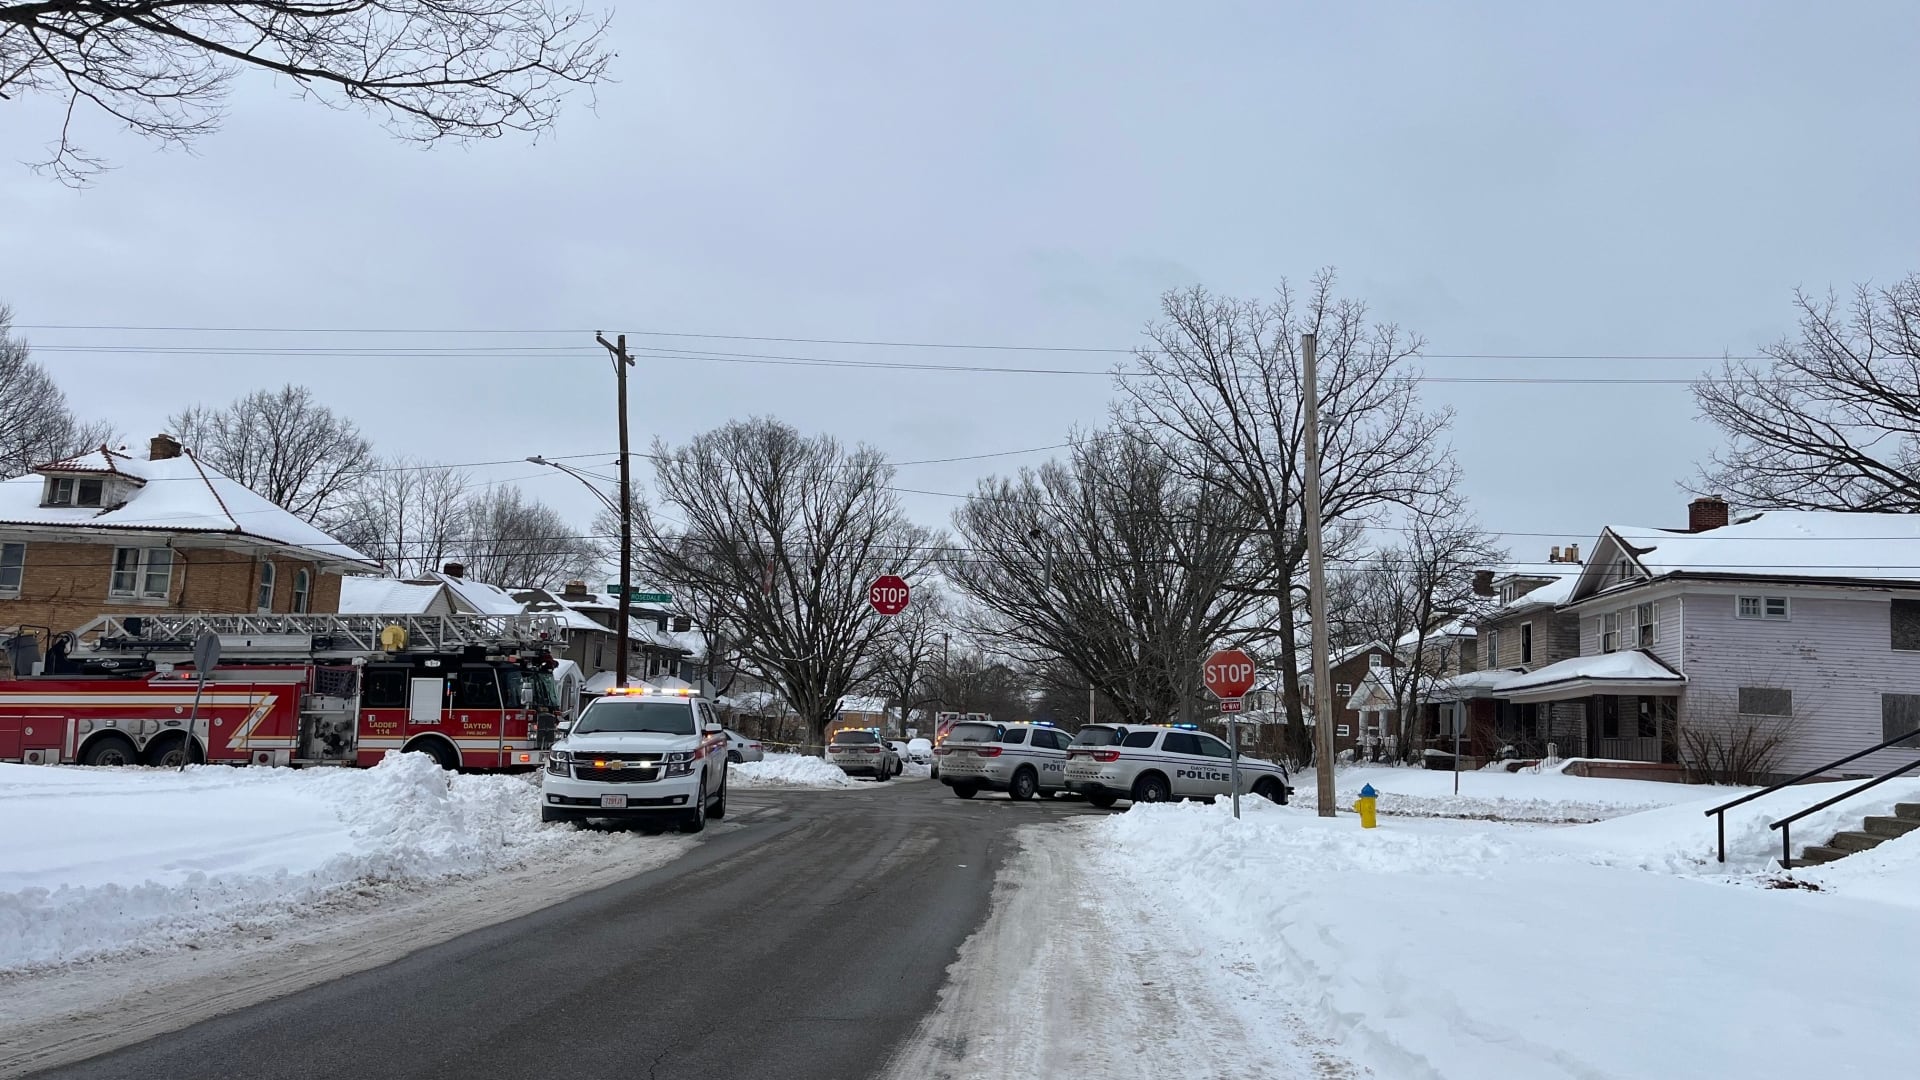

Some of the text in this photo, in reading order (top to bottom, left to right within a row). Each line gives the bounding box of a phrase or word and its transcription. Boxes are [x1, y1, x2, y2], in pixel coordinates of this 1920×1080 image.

[631, 593, 661, 602] ROSEDALE
[872, 587, 907, 603] STOP
[1206, 663, 1251, 683] STOP
[1042, 763, 1066, 772] POLI
[1176, 769, 1230, 782] POLICE
